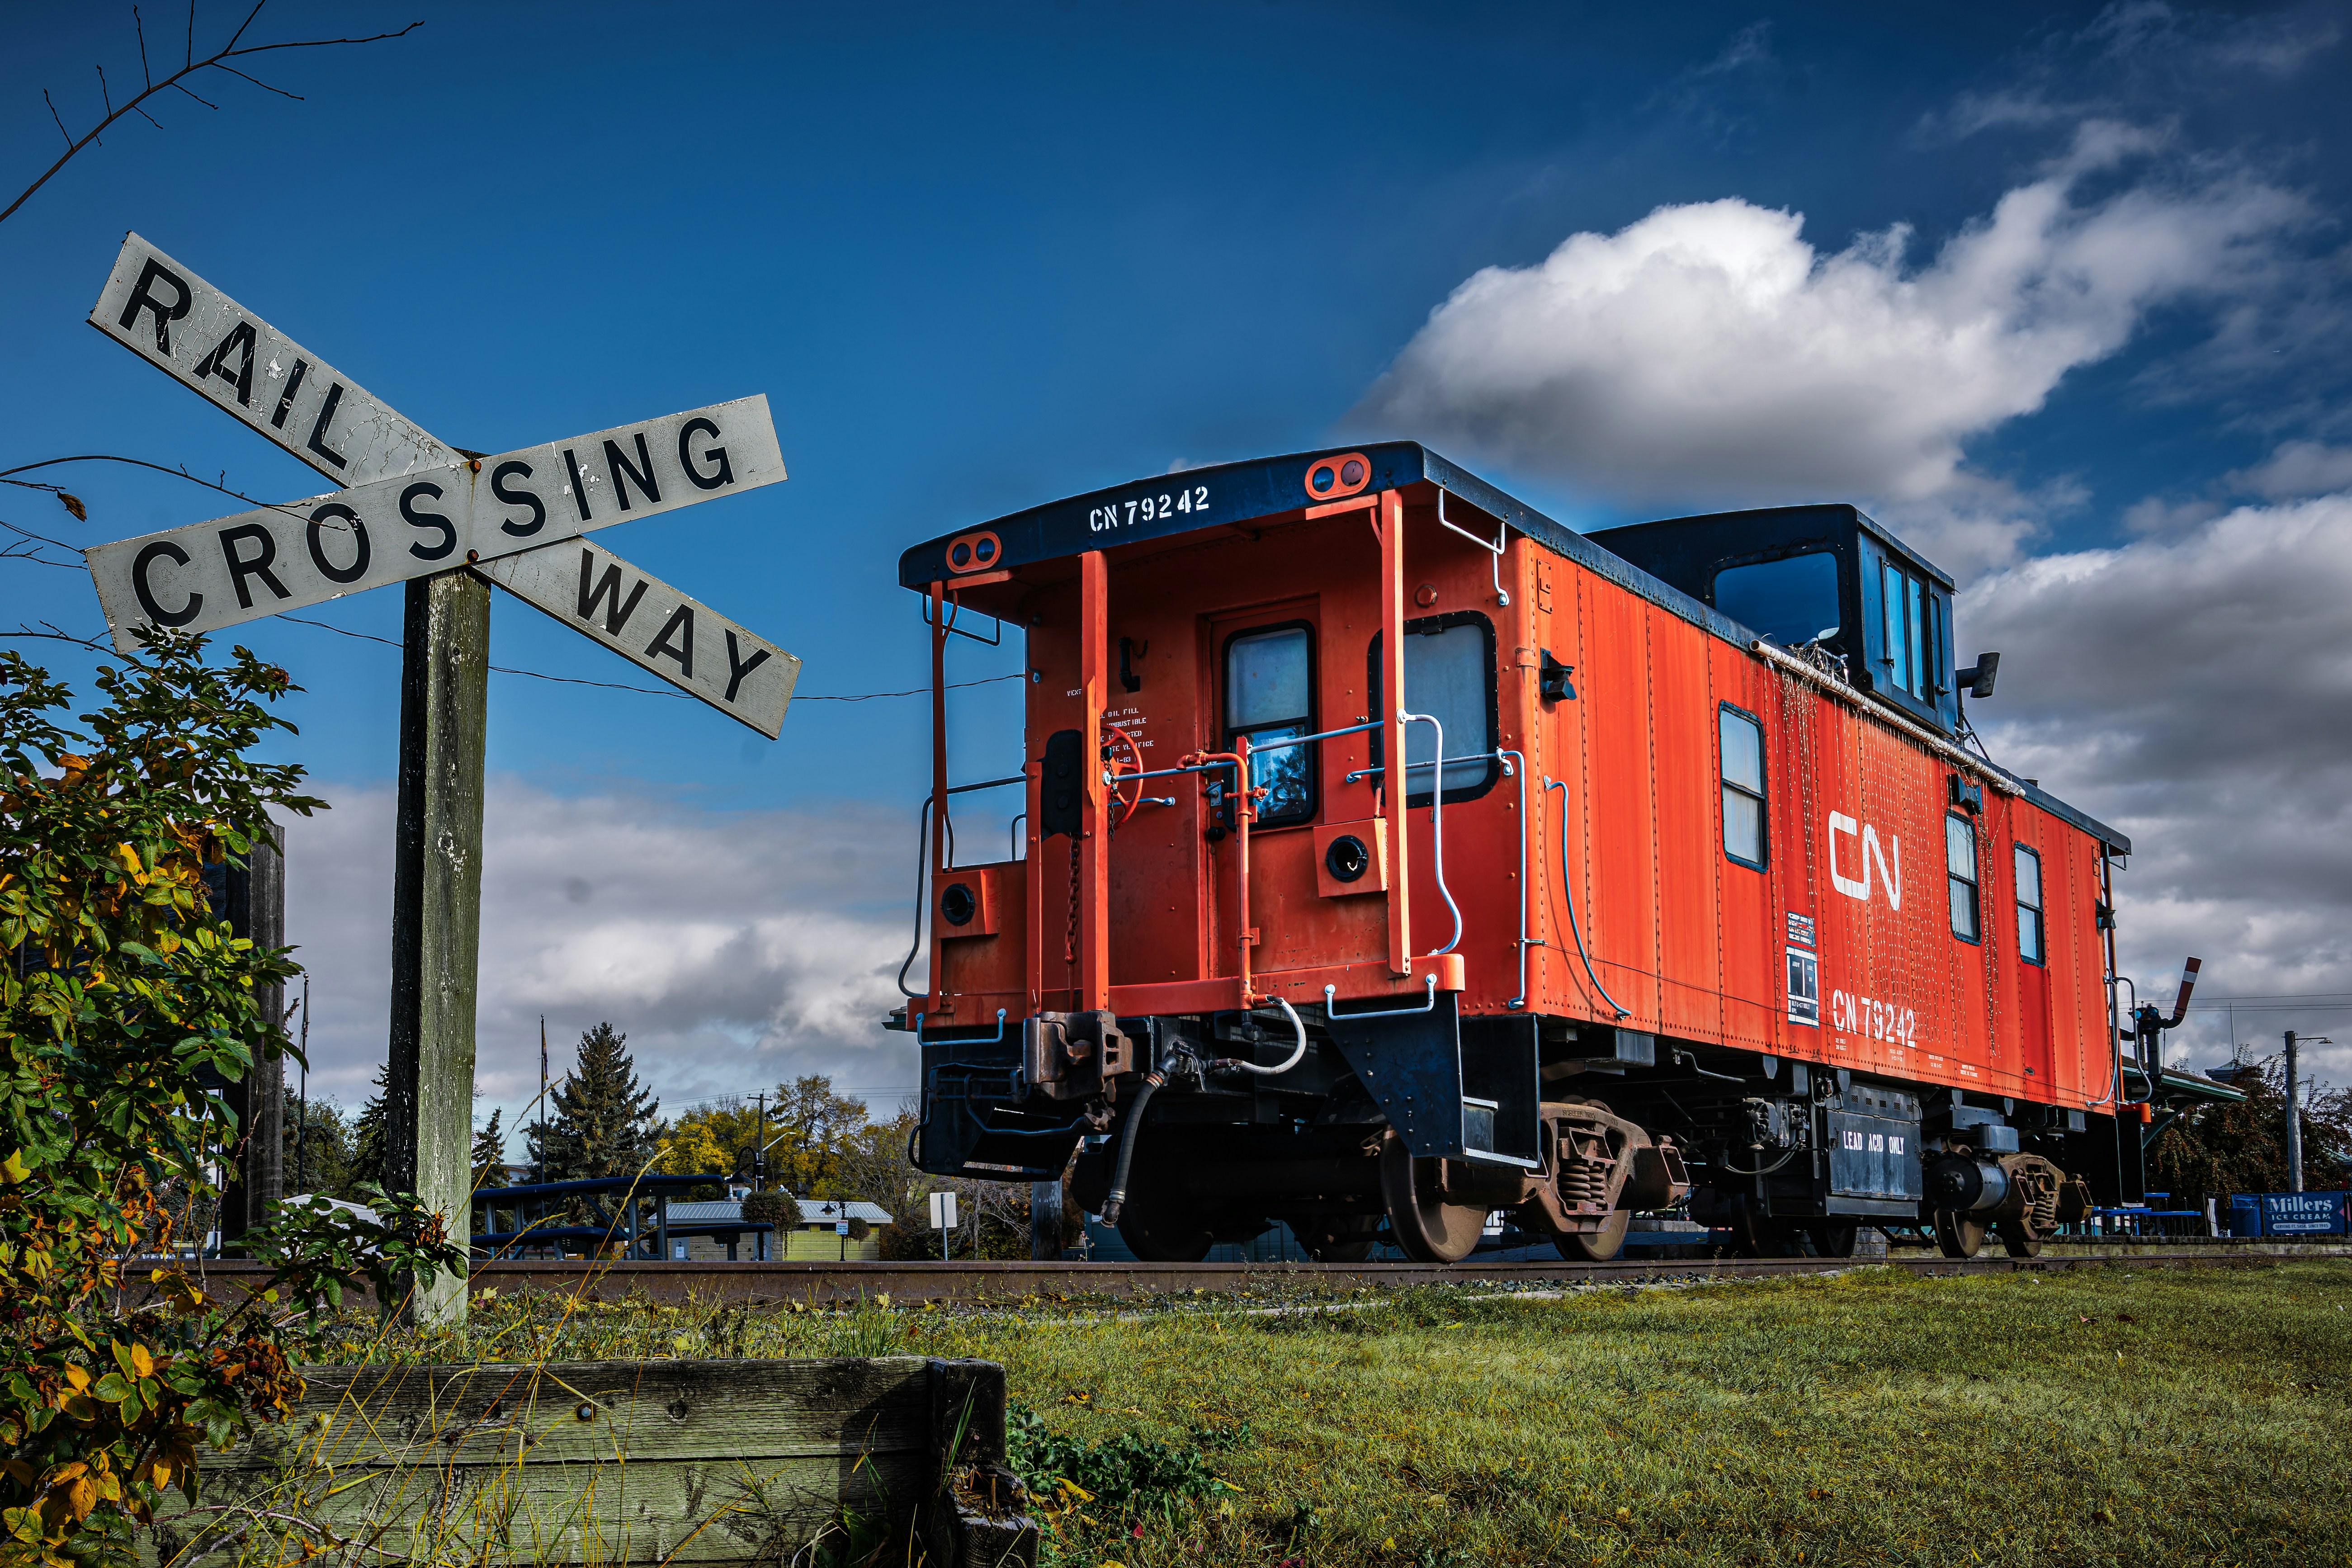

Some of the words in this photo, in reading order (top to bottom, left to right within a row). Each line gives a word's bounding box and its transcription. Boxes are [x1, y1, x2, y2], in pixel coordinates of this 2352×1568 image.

[118, 255, 349, 471] RAIL
[576, 548, 772, 704] WAY
[1090, 504, 1117, 532] CN
[1125, 486, 1209, 525] 79242
[131, 416, 736, 628] CROSSING
[1828, 809, 1901, 911] CN
[1832, 989, 1857, 1035] CN
[1861, 997, 1915, 1048] 79242
[1843, 1130, 1863, 1151] LEAD
[1868, 1133, 1884, 1152] ACID
[1889, 1136, 1904, 1155] ONLY
[2269, 1196, 2333, 1213] Millers
